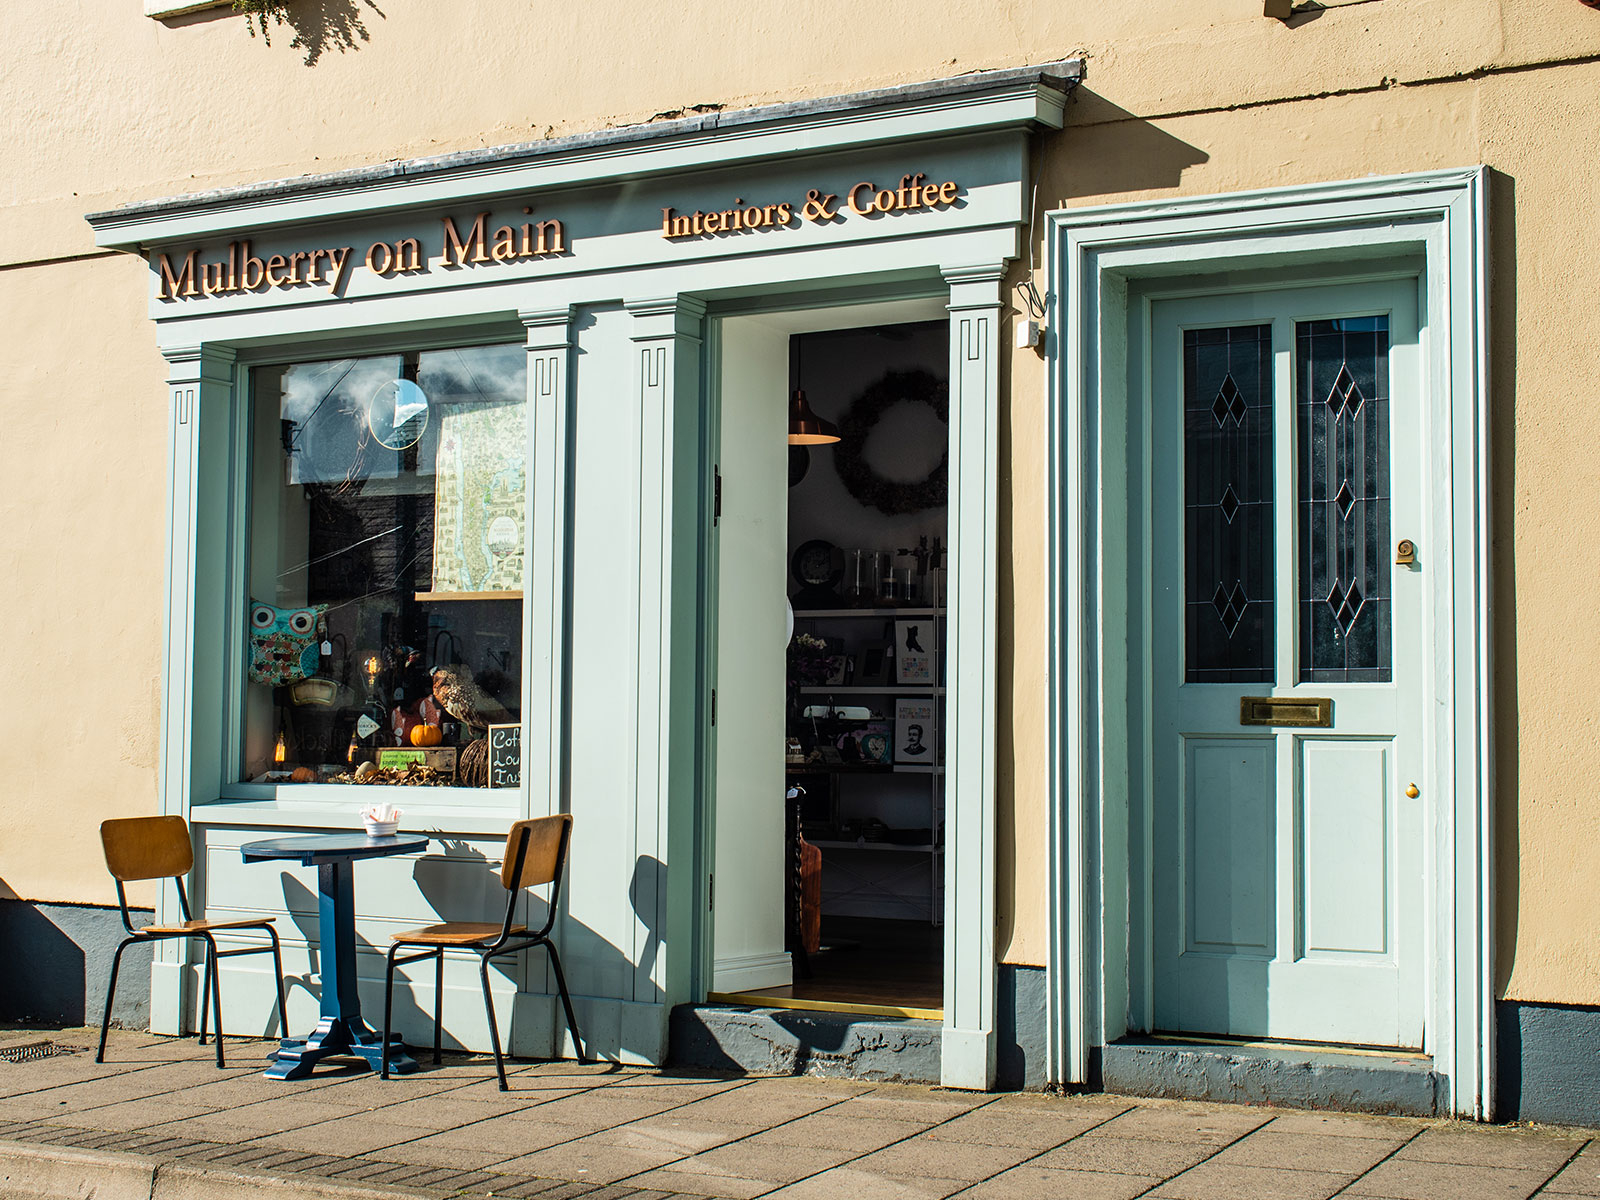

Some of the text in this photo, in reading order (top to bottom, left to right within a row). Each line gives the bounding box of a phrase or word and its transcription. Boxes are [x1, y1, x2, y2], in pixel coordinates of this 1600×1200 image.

[661, 172, 959, 239] Interiors & Coffee
[155, 206, 566, 300] Mulberry on Main
[493, 727, 520, 749] Cof
